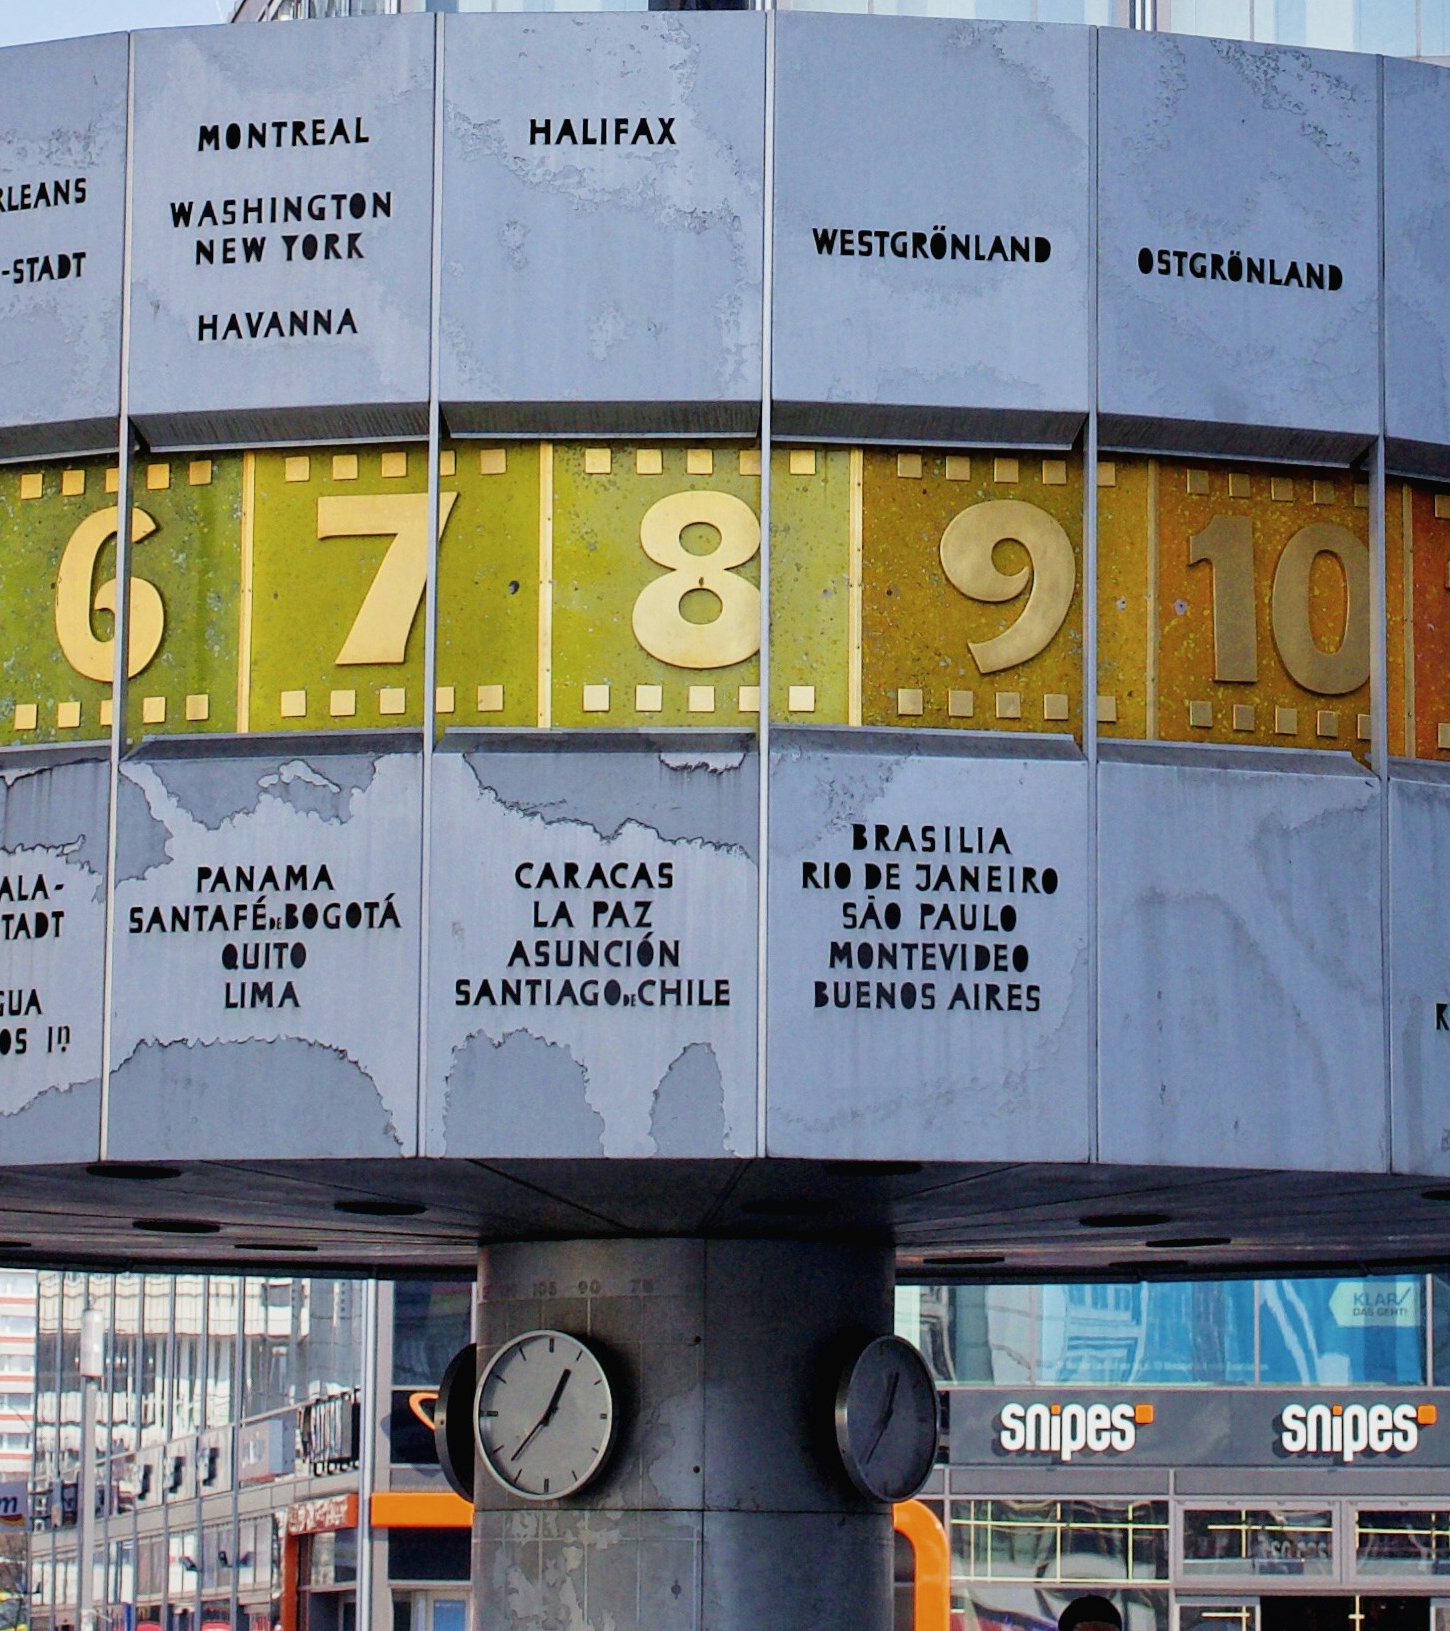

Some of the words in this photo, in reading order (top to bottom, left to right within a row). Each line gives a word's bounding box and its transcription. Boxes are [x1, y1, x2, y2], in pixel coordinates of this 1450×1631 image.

[197, 116, 370, 152] MONTREAL
[529, 117, 676, 146] HALIFAX
[170, 191, 391, 228] WASHINGTON
[195, 236, 267, 266] NEW
[281, 232, 364, 262] YORK
[812, 224, 1052, 263] WESTGRÖNLAND
[1137, 247, 1343, 291] OSTGRÖNLAND
[198, 307, 358, 342] HAVANNA
[54, 505, 165, 684] 6
[317, 490, 459, 666] 7
[632, 489, 762, 669] 8
[939, 499, 1076, 675] 9
[1188, 514, 1373, 696] 10
[850, 823, 1012, 855] BRASILIA
[196, 864, 335, 894] PANAMA
[514, 862, 673, 889] CARACAS
[802, 861, 852, 890] RIO
[915, 863, 1058, 895] JANEIRO
[533, 900, 574, 928] LA
[592, 900, 653, 928] PAZ
[842, 895, 902, 930] SÃO
[919, 903, 1017, 933] PAULO
[221, 941, 307, 971] QUITO
[507, 931, 680, 968] ASUNCIÓN
[829, 941, 1029, 973] MONTEVIDEO
[225, 981, 301, 1009] LIMA
[814, 980, 936, 1010] BUENOS
[947, 982, 1040, 1012] AIRES
[1000, 1403, 1136, 1462] snipes
[1282, 1403, 1418, 1463] snipes
